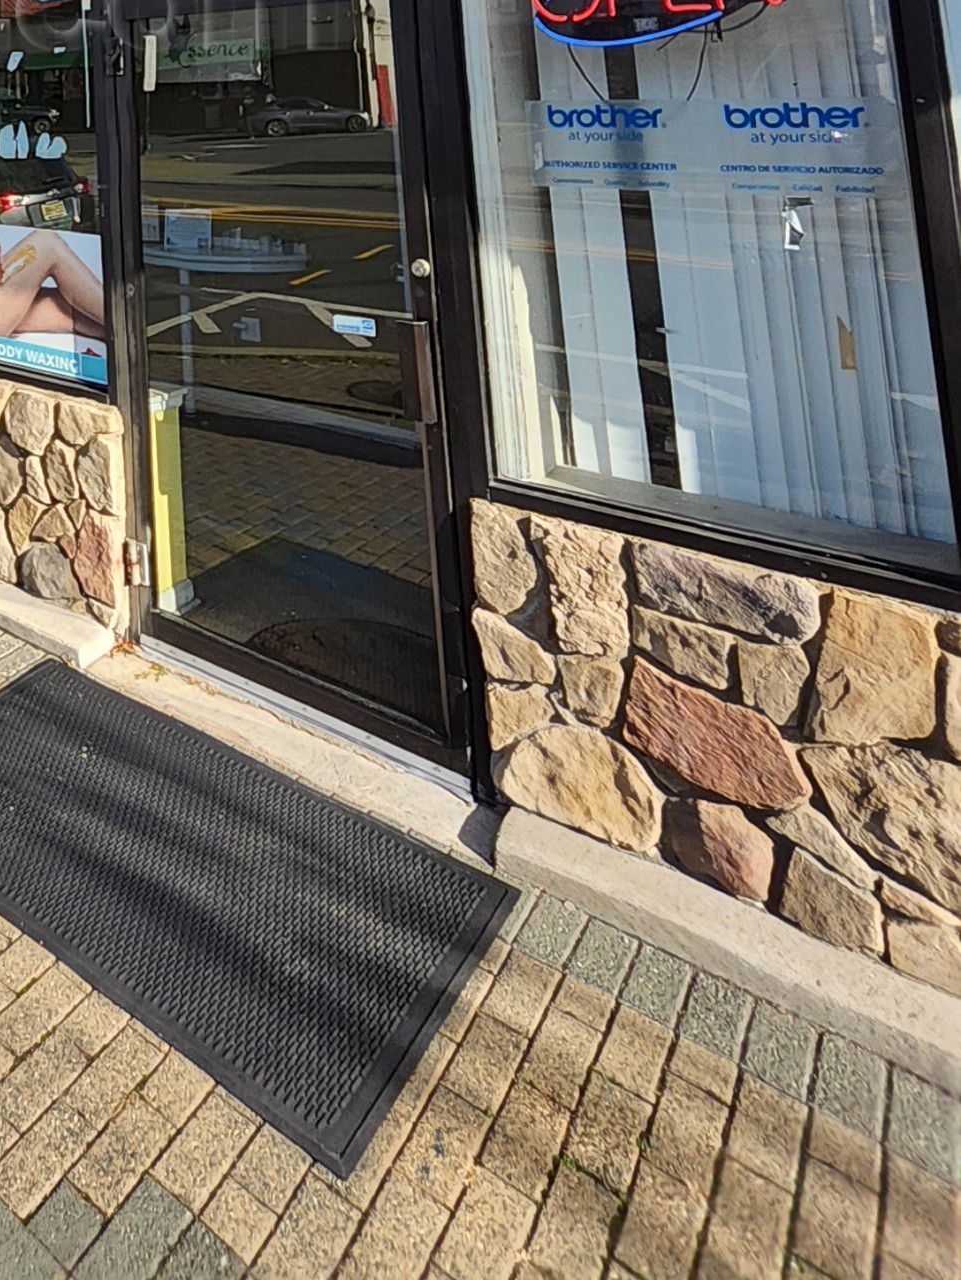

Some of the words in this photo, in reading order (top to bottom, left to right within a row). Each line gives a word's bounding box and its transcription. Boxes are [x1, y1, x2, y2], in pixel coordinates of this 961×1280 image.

[546, 104, 663, 129] brother
[723, 102, 866, 129] brother
[568, 131, 582, 141] at
[584, 132, 613, 144] your
[616, 131, 644, 142] side
[751, 132, 765, 143] at
[767, 132, 806, 146] your
[640, 162, 677, 171] CENTER
[720, 164, 756, 172] CENTRO
[758, 165, 771, 173] DE
